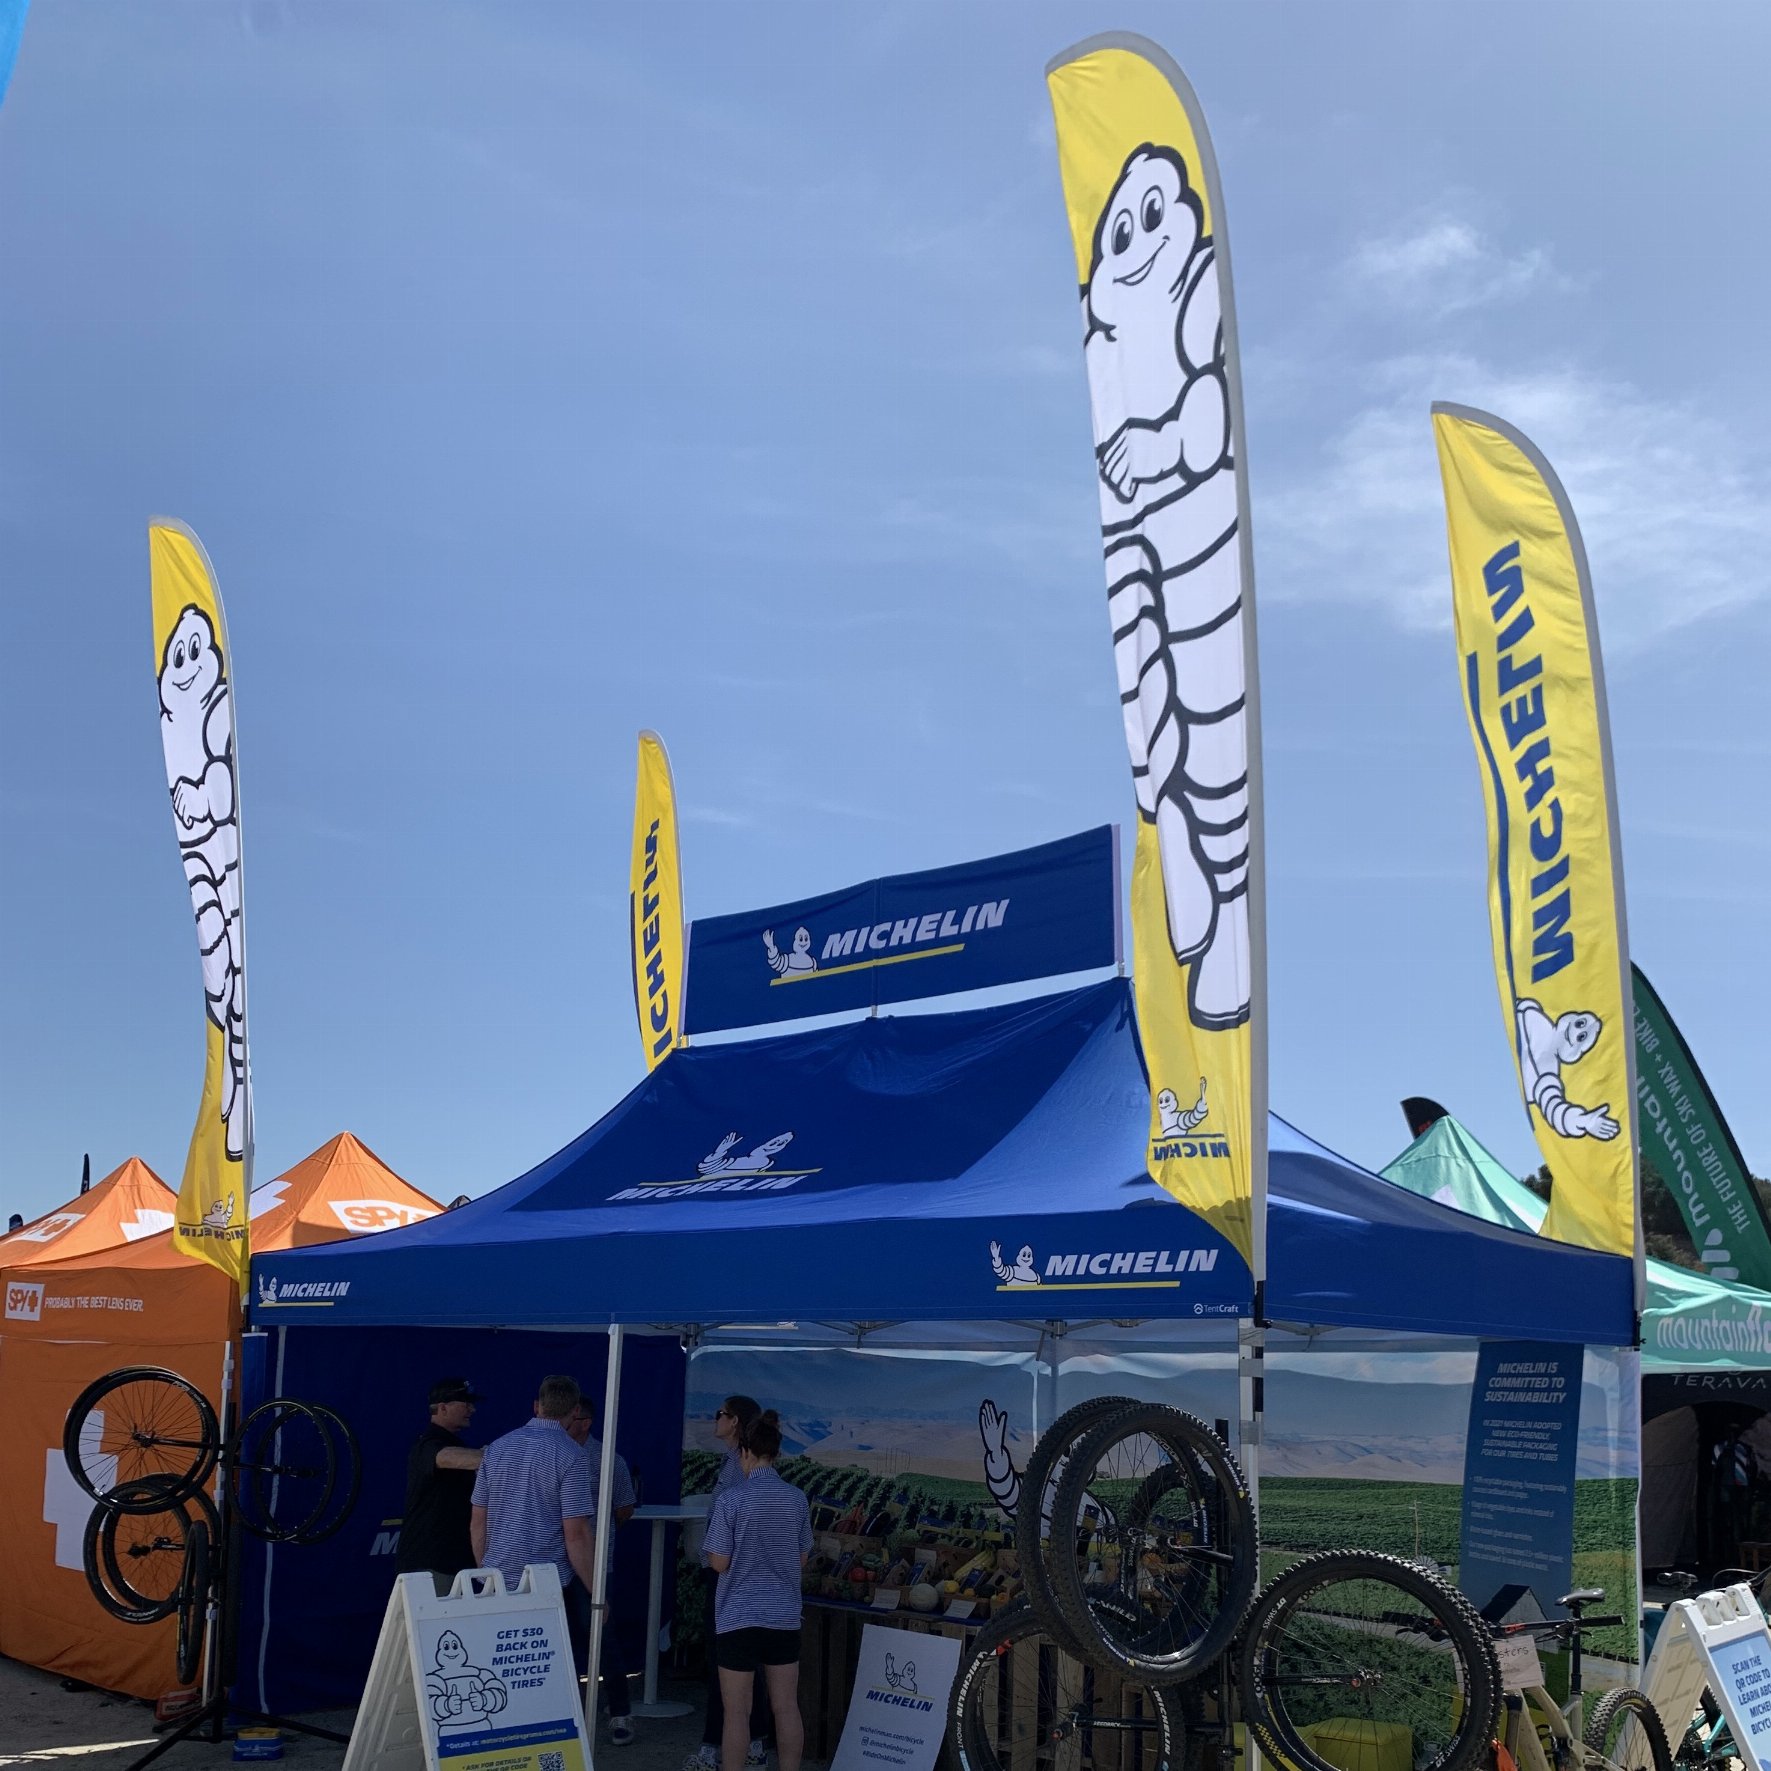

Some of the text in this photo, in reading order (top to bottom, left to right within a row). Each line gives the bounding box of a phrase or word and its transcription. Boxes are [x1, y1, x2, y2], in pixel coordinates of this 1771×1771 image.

[821, 898, 1011, 960] MICHELIN
[1658, 1061, 1682, 1099] WAX
[1674, 1094, 1696, 1123] SKI
[1685, 1123, 1706, 1145] OF
[1696, 1142, 1737, 1203] FUTURE
[605, 1175, 809, 1201] MICHELIN
[1727, 1199, 1751, 1234] THE
[1045, 1249, 1219, 1276] MICHELIN
[278, 1281, 350, 1298] MICHELIN
[44, 1296, 75, 1309] PROBABLY
[76, 1296, 89, 1308] THE
[90, 1296, 107, 1308] BEST
[107, 1297, 124, 1310] LENS
[1203, 1304, 1239, 1313] TentCraft
[1497, 1362, 1559, 1374] MICHELIN IS
[1488, 1377, 1565, 1388] COMMITTED TO
[1484, 1391, 1567, 1403] SUSTAINABILITY
[496, 1629, 520, 1640] GET
[495, 1639, 549, 1653] BACK ON
[501, 1664, 551, 1678] BICYCLE
[1731, 1655, 1762, 1675] SCAN THE
[1735, 1668, 1771, 1692] QR CODE TO
[866, 1689, 933, 1713] MICHELIN
[1738, 1688, 1760, 1706] LEARN
[1153, 1690, 1171, 1756] MICHELIN
